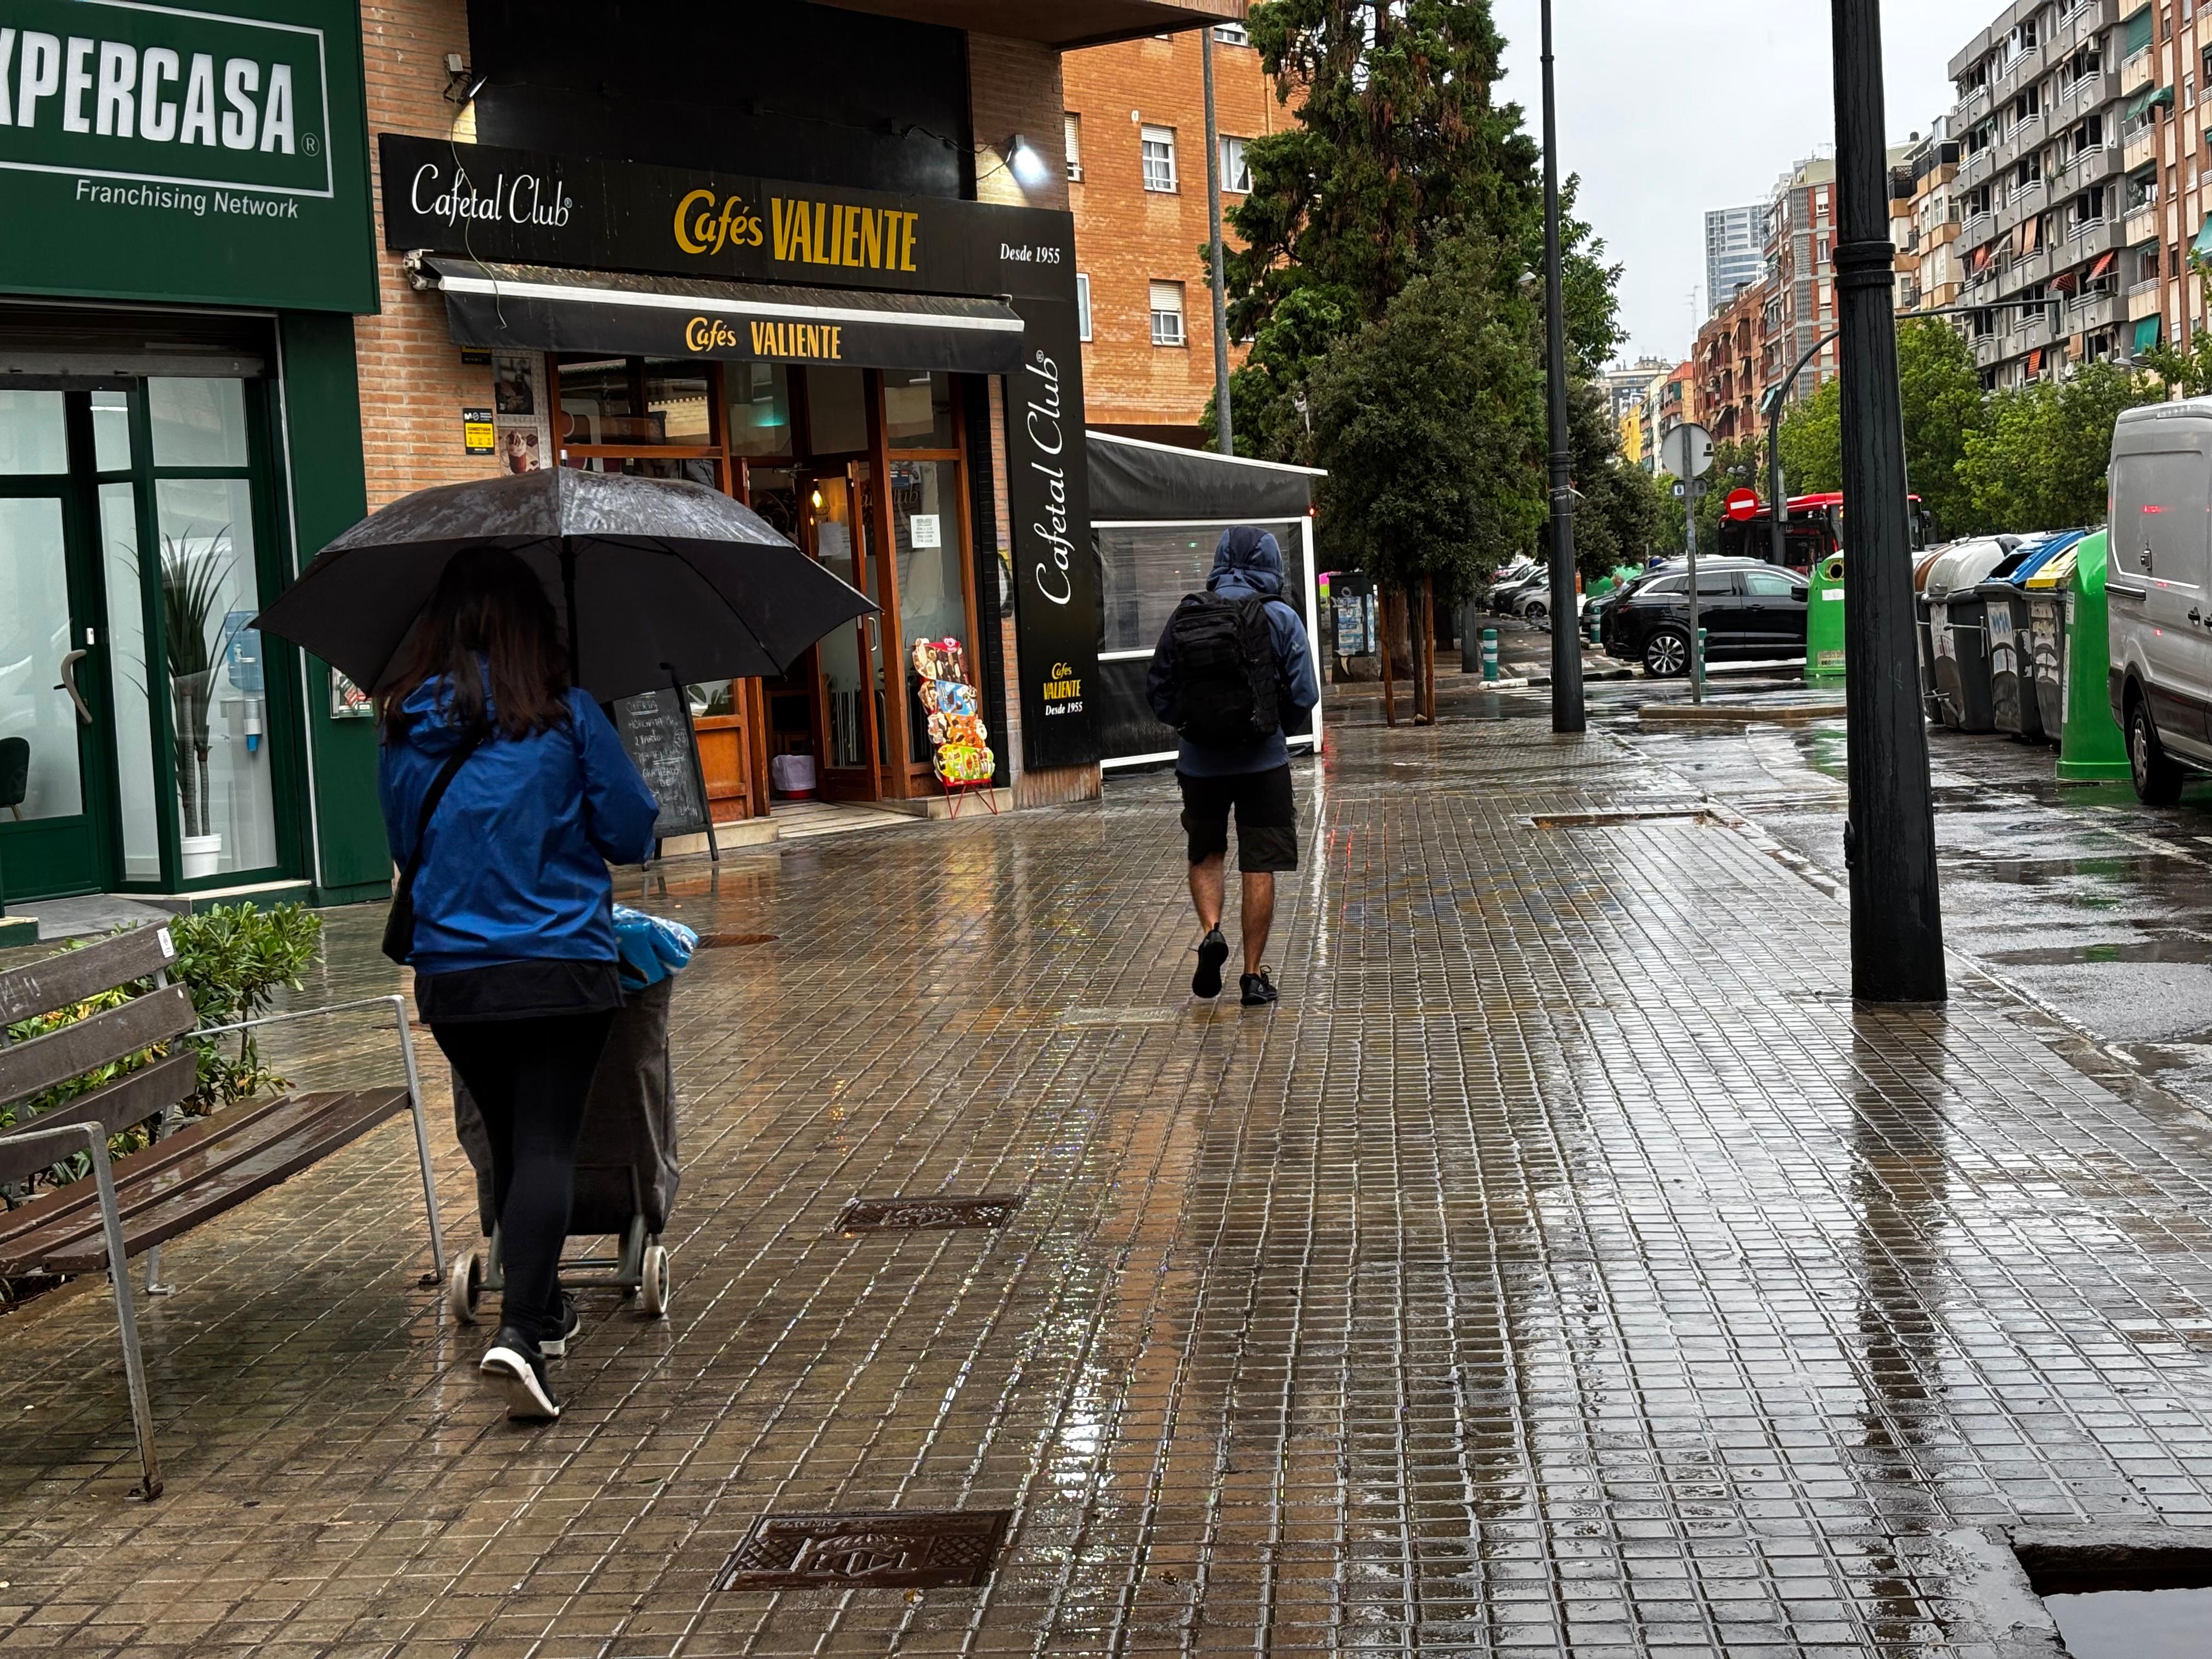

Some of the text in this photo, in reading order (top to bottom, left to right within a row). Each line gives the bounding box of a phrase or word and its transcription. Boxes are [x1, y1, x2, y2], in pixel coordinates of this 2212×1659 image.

[75, 178, 299, 219] Franchising Network
[411, 163, 503, 227] Cafetal
[673, 189, 919, 272] Cafés VALIENTE
[1000, 243, 1060, 264] Desde 1955
[685, 317, 842, 360] Cafés VALIENTE
[1035, 462, 1075, 605] Cafetal
[1043, 679, 1082, 701] VALIENTE
[1045, 701, 1083, 716] Desde 1955
